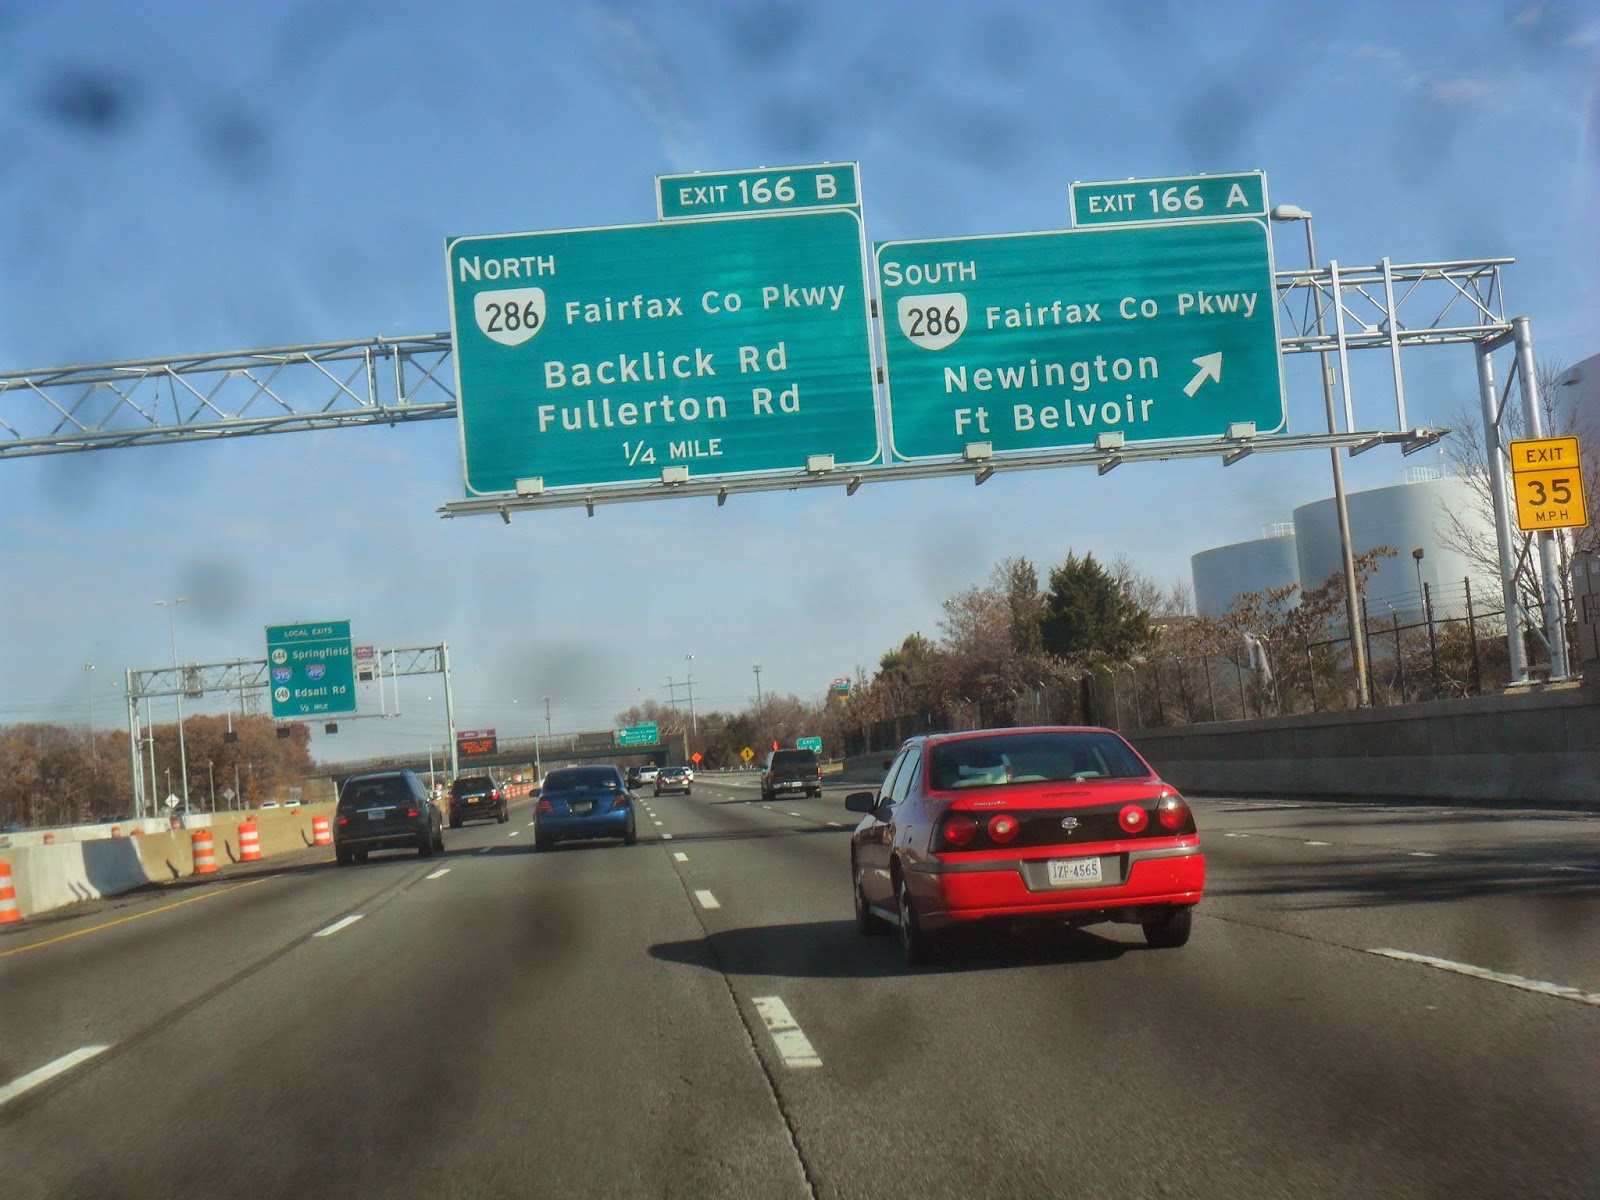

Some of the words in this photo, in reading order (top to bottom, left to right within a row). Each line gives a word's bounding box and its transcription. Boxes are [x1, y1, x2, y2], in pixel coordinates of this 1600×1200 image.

[679, 185, 728, 206] EXIT
[738, 176, 796, 205] 166
[815, 174, 838, 199] B
[1088, 193, 1136, 214] EXIT
[1149, 185, 1204, 213] 166
[1226, 183, 1250, 208] A
[459, 255, 556, 282] NORTH
[883, 260, 977, 287] SOUTH
[485, 300, 540, 333] 286
[565, 294, 683, 325] Fairfax
[702, 290, 742, 315] Co
[762, 283, 845, 311] Pkwy
[986, 300, 1100, 330] Fairfax
[1120, 296, 1158, 319] Co
[1178, 290, 1258, 318] Pkwy
[908, 305, 961, 337] 286
[544, 347, 716, 389] Backlick
[739, 341, 788, 373] Rd
[944, 355, 1159, 394] Newington
[538, 394, 728, 433] Fullerton
[752, 383, 800, 415] Rd
[954, 407, 990, 436] Ft
[1013, 394, 1154, 432] Belvoir
[669, 438, 724, 460] MILE
[1526, 447, 1563, 463] EXIT
[1527, 478, 1571, 506] 35
[284, 629, 308, 638] LOCAL
[312, 627, 333, 636] EXITS
[292, 647, 349, 660] Springfield
[295, 687, 328, 698] Edsall
[332, 685, 346, 695] Rd
